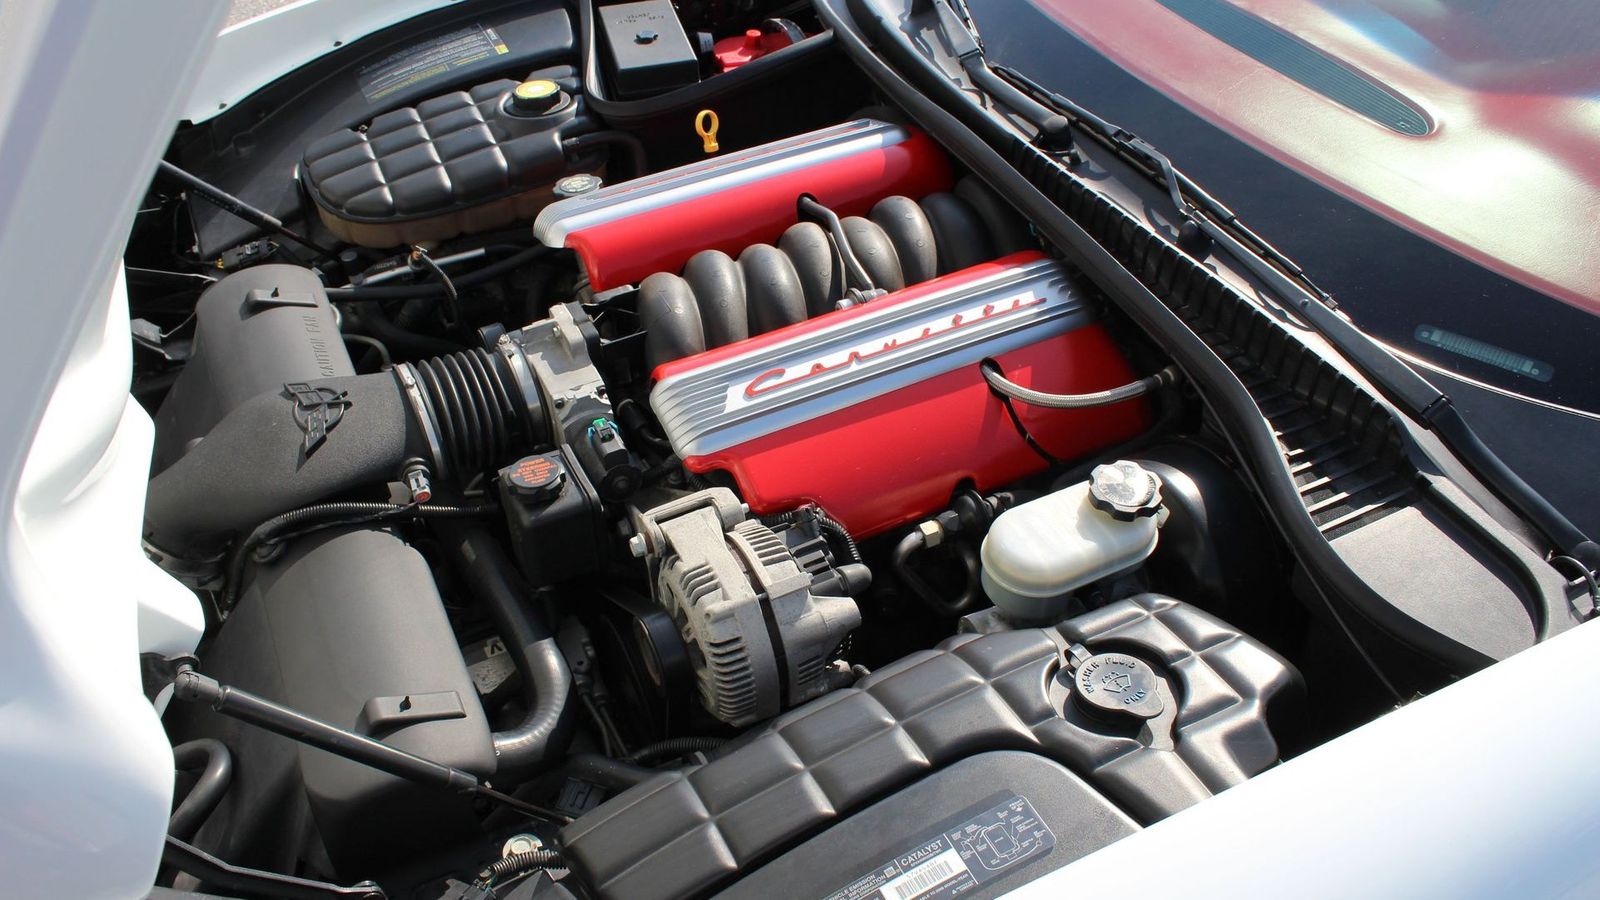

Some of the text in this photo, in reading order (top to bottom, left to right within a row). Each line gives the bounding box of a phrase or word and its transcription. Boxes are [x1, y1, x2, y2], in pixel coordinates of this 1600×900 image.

[743, 297, 1047, 397] Corvette
[1081, 656, 1137, 694] WASHER FLUID
[1123, 688, 1147, 705] ONLY
[901, 840, 943, 866] CATALYST
[848, 874, 887, 898] INFORMATION
